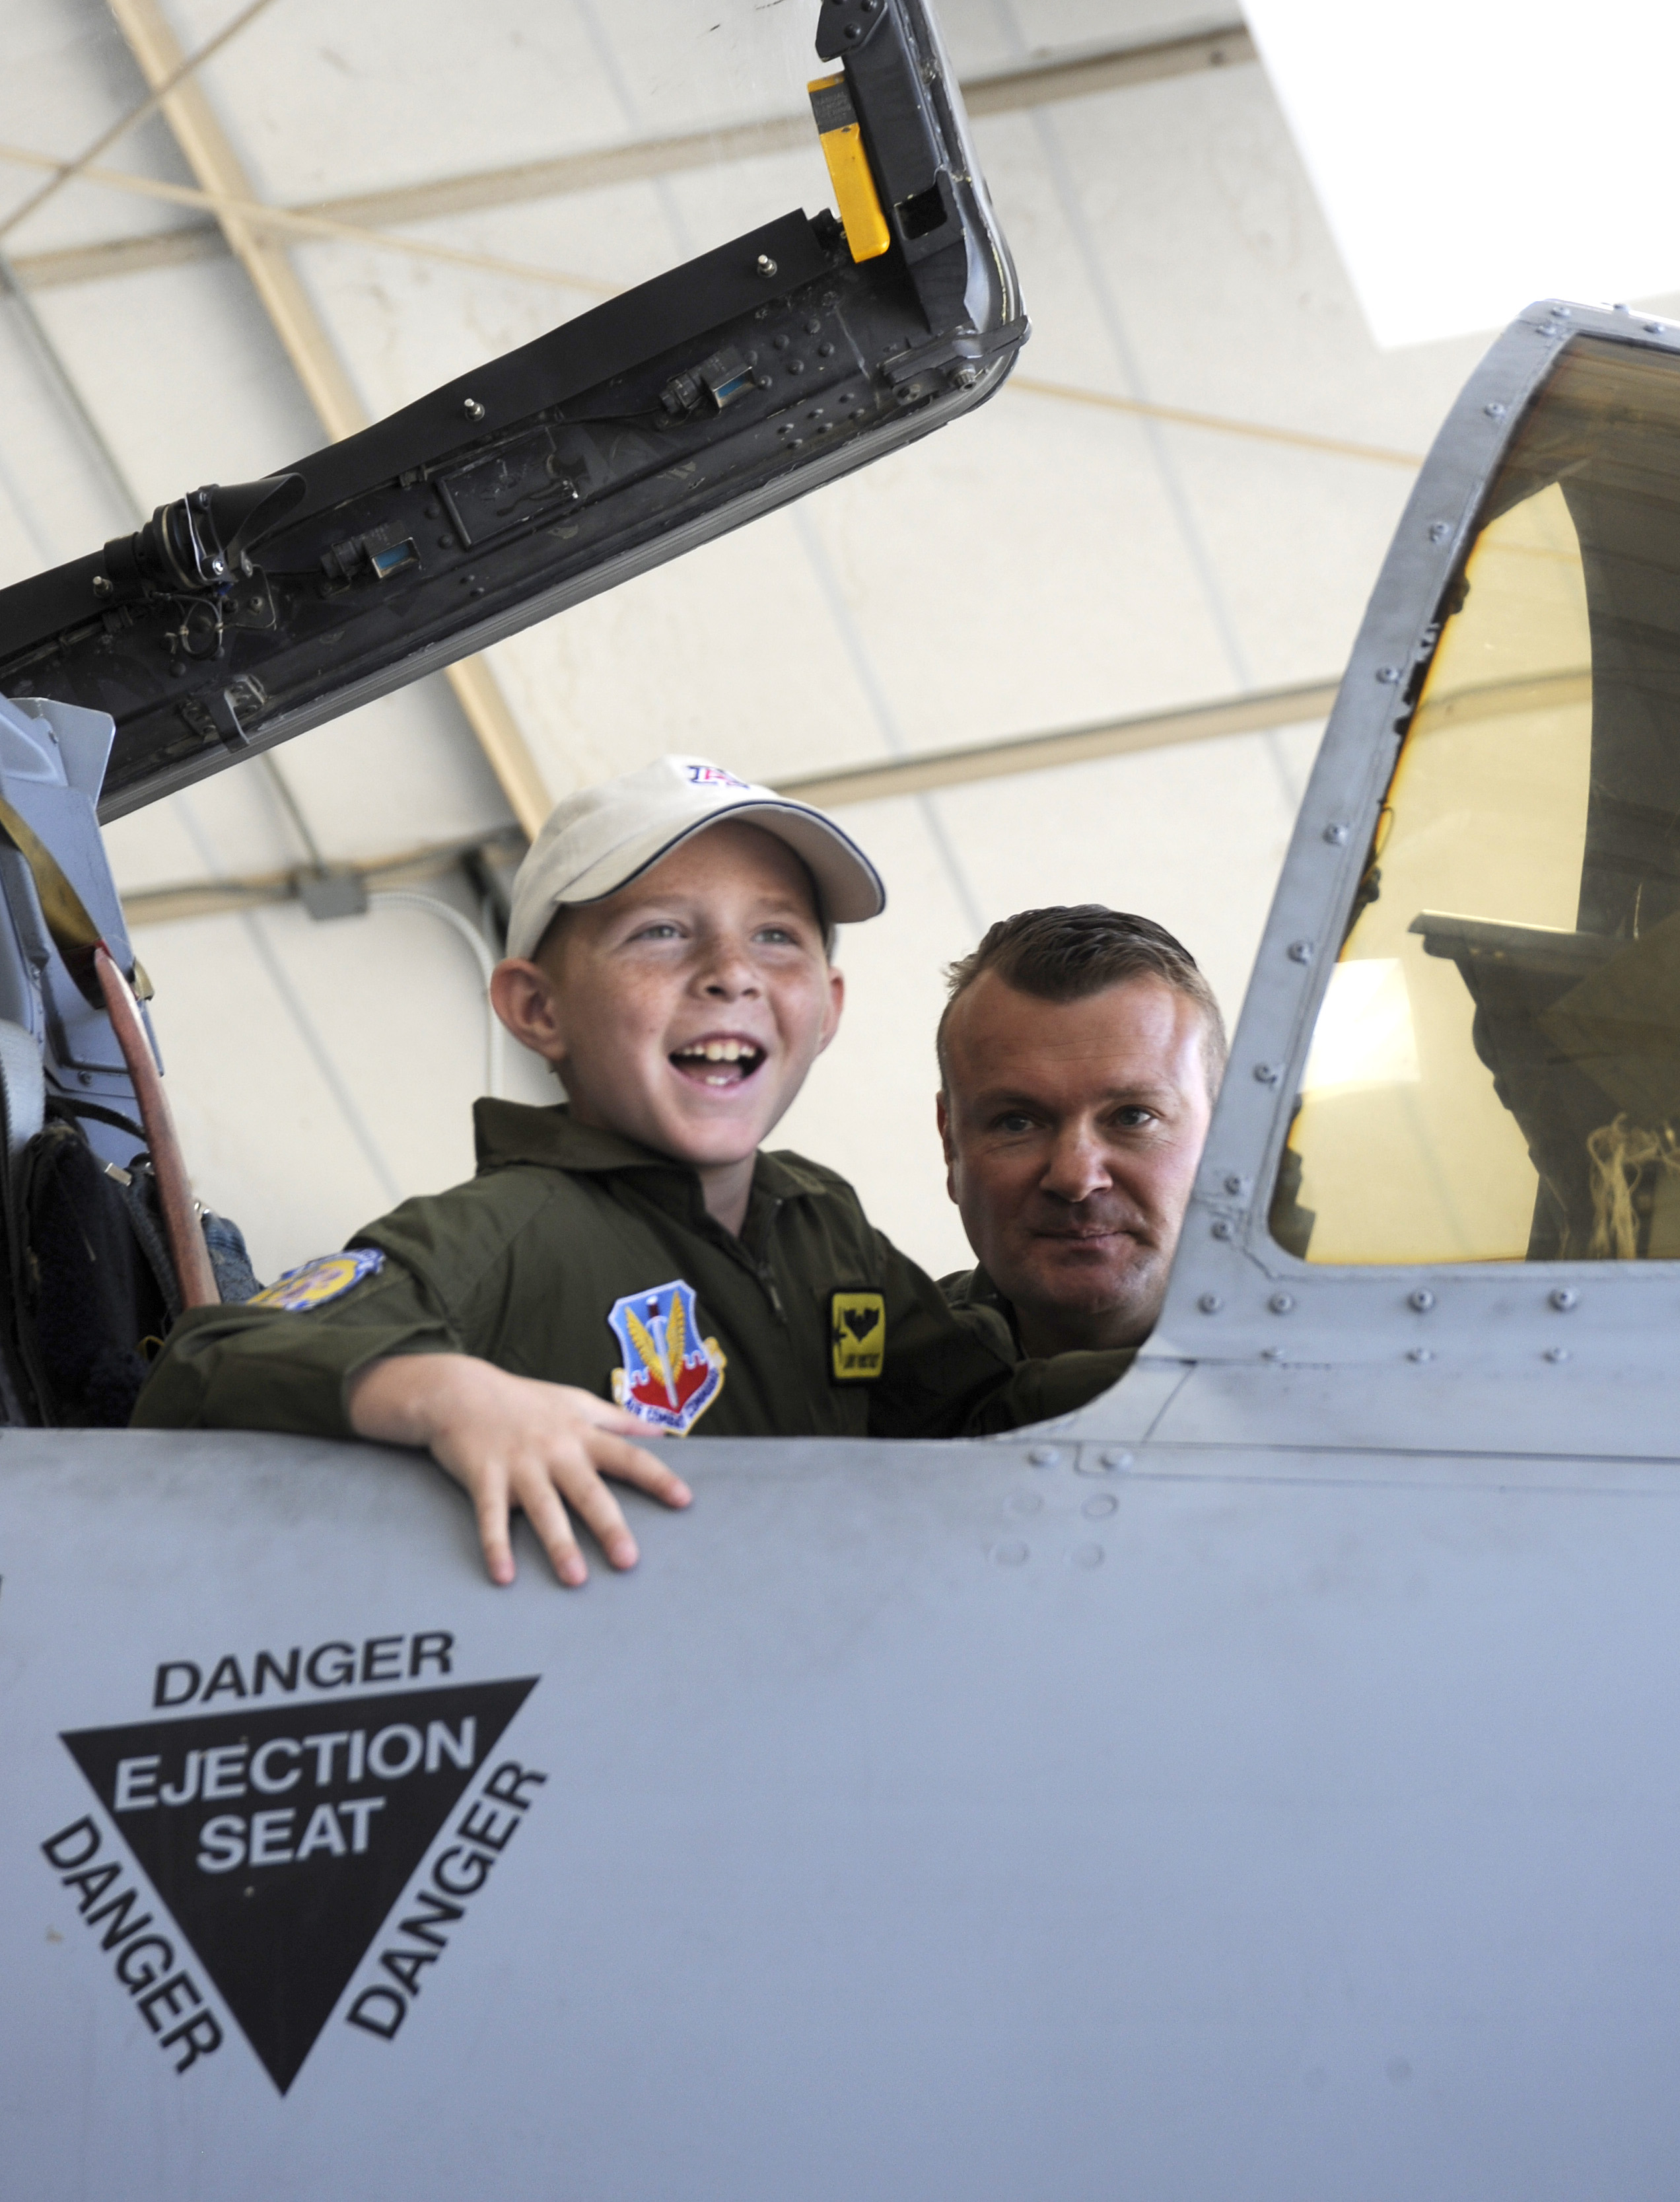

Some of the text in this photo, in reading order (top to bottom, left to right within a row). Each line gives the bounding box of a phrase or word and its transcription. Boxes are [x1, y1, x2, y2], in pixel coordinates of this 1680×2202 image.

[153, 1630, 455, 1709] DANGER
[114, 1716, 477, 1812] EJECTION
[196, 1796, 387, 1873] SEAT
[40, 1814, 225, 2075] DANGER
[345, 1759, 548, 2042] DANGER
